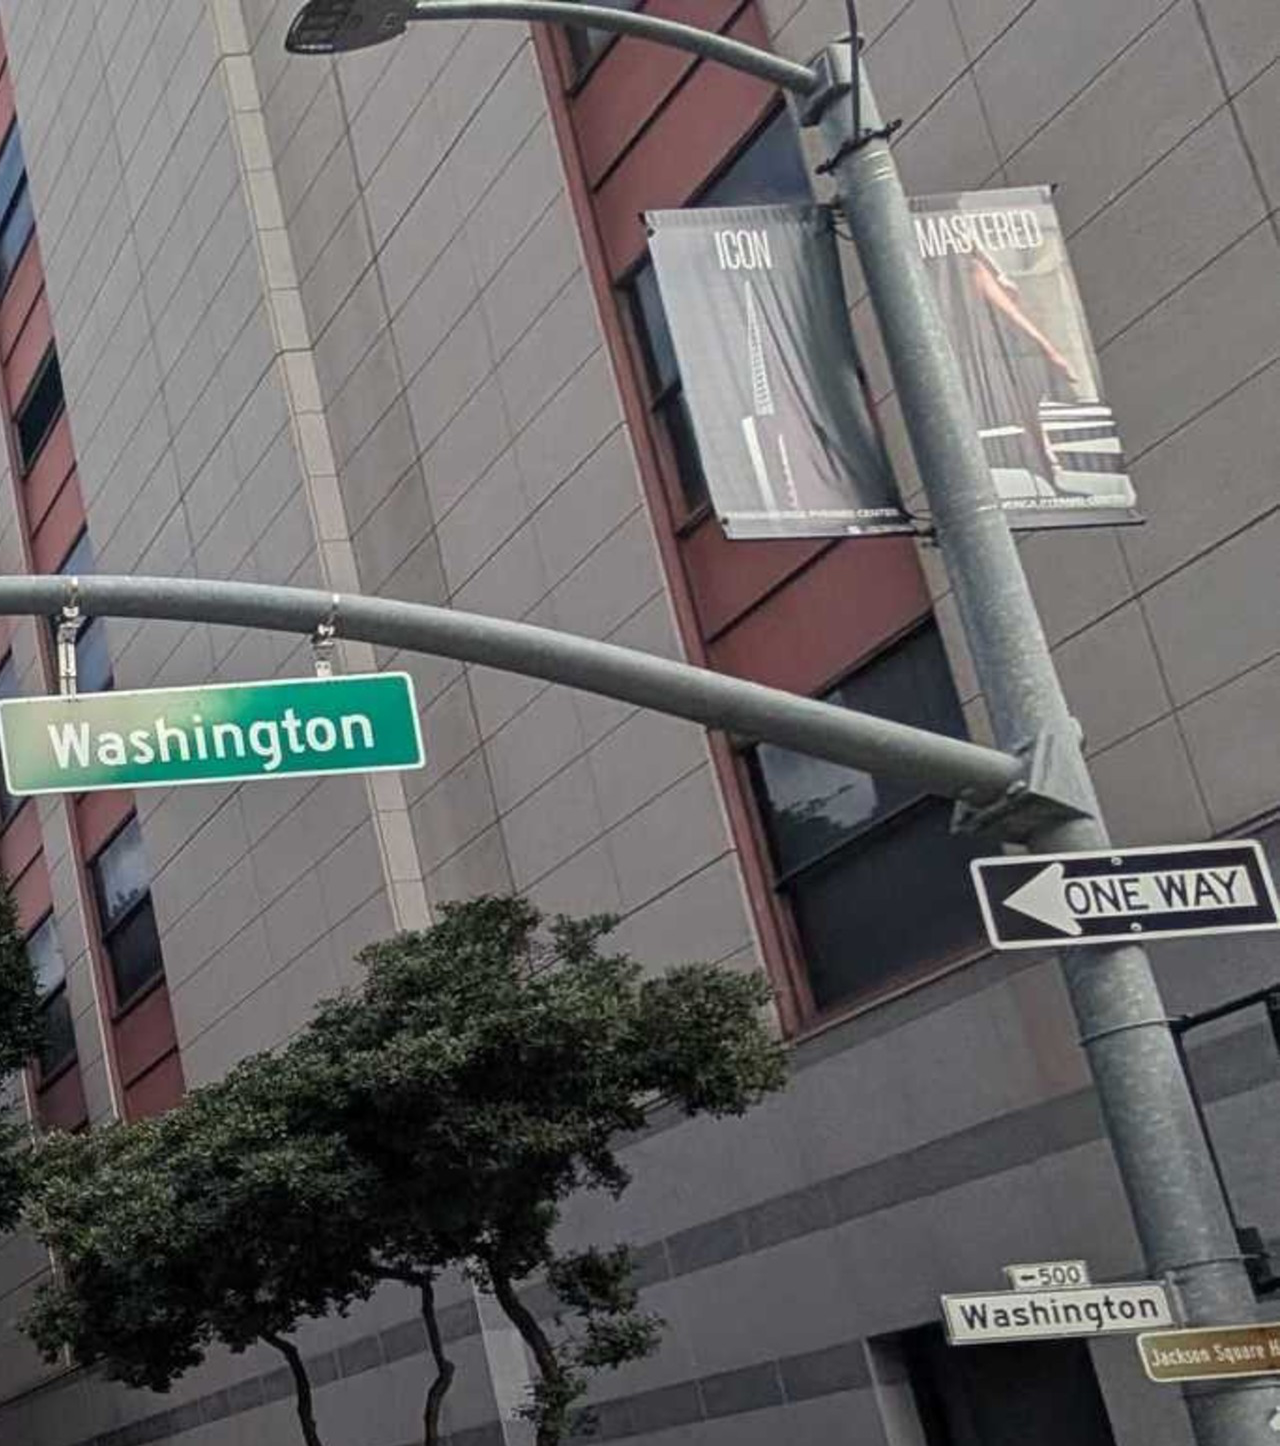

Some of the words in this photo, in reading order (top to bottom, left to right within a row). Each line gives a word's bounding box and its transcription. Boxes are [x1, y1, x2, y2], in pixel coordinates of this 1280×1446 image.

[713, 229, 773, 270] ICON
[914, 208, 1043, 258] MASTERED
[46, 707, 376, 772] Washington
[1063, 877, 1149, 915] ONE
[1153, 869, 1238, 908] WAY
[1038, 1265, 1082, 1286] 500
[959, 1295, 1159, 1331] Washington
[1151, 1347, 1211, 1367] Jackson
[1212, 1343, 1265, 1364] Square
